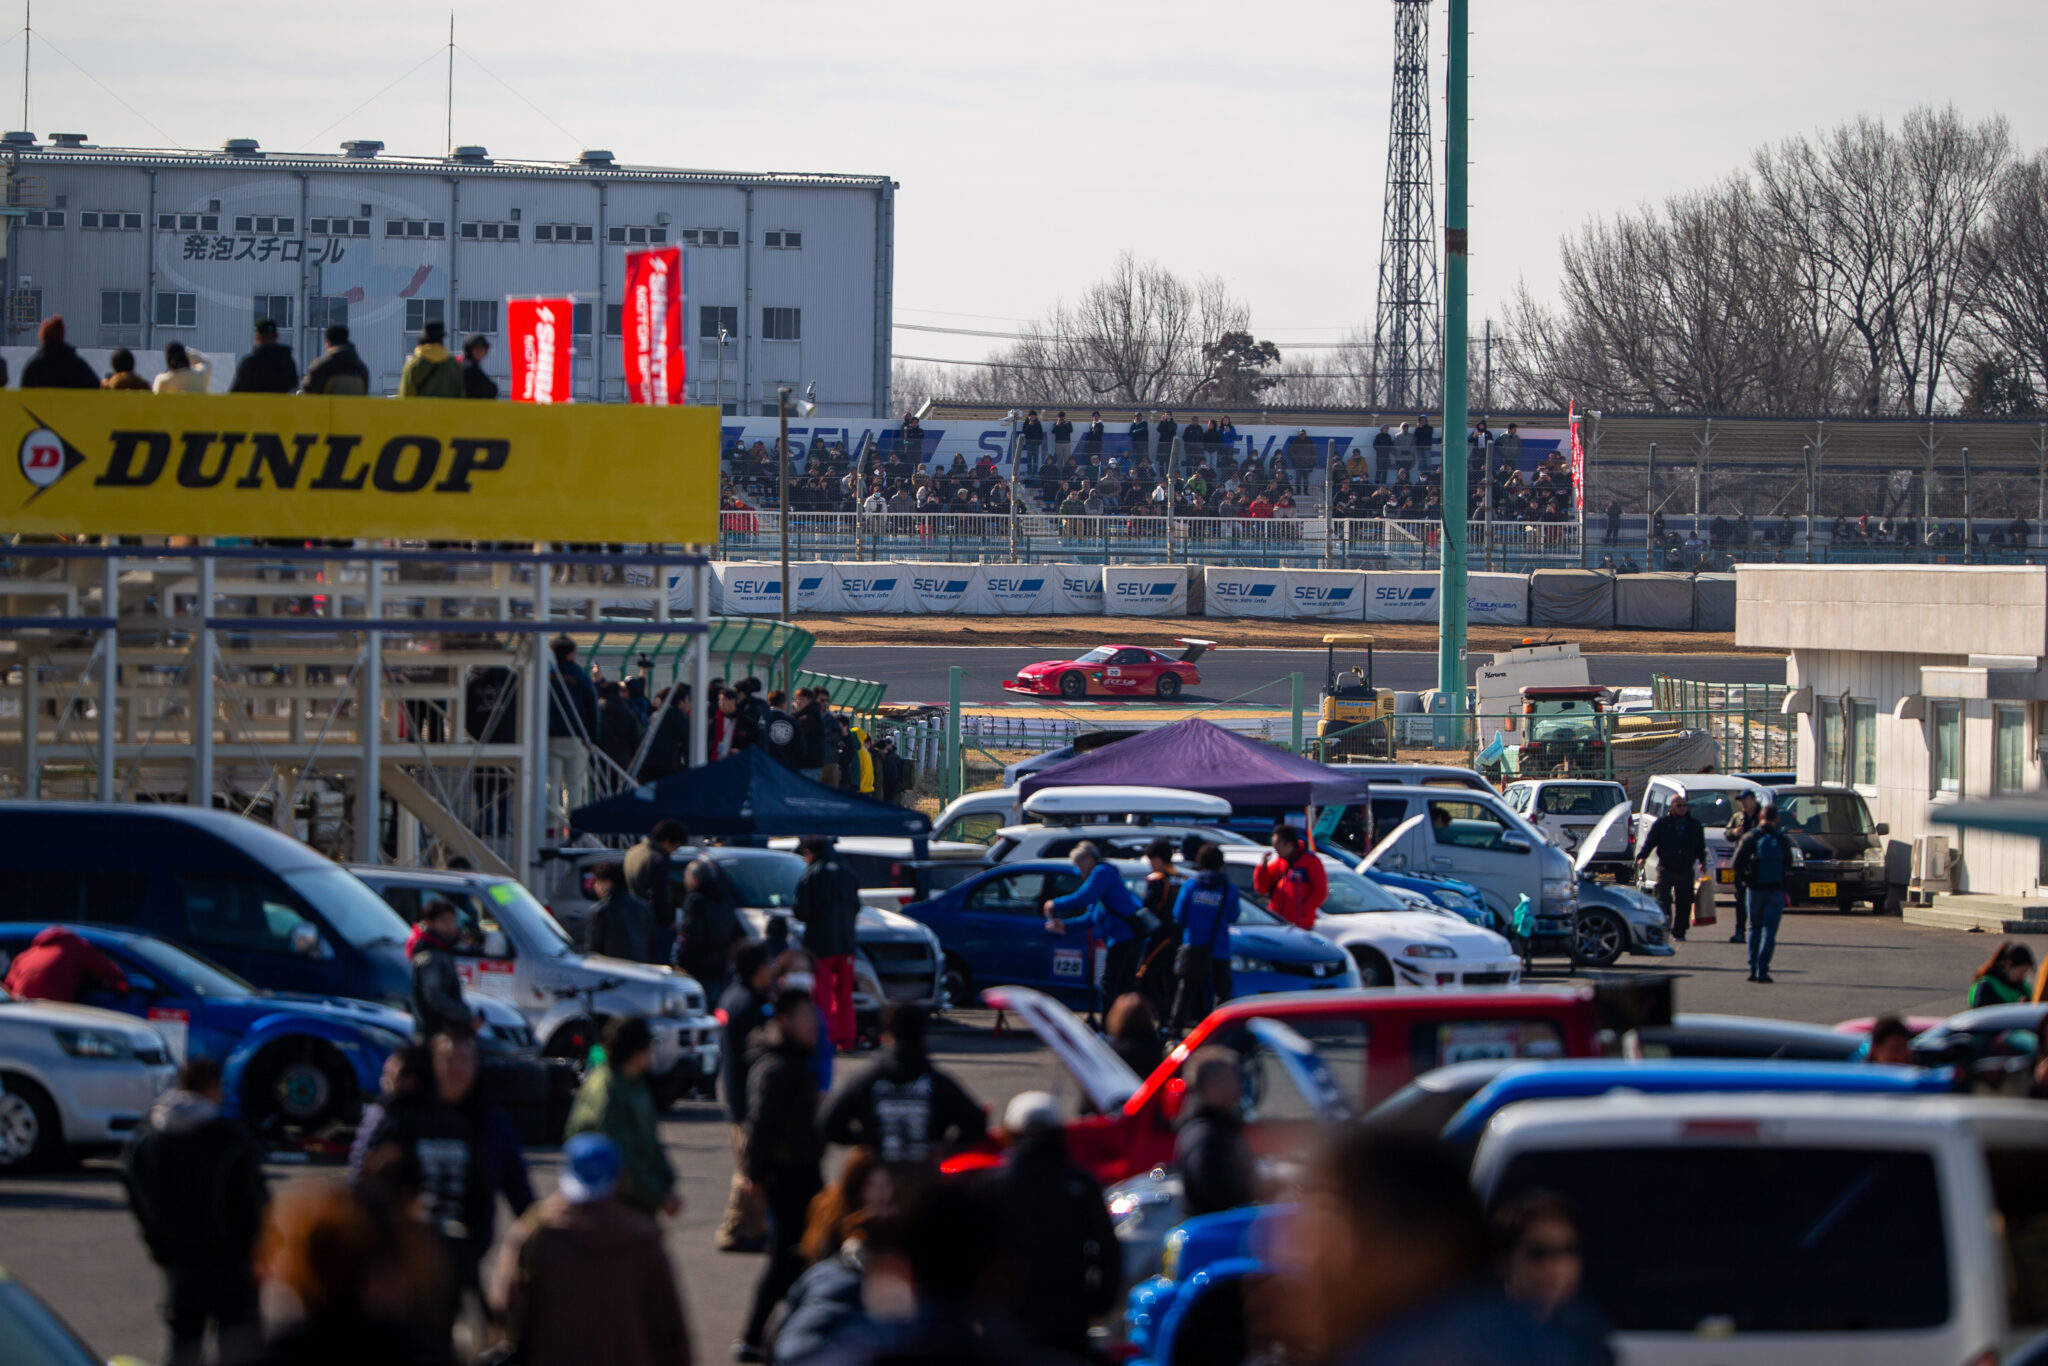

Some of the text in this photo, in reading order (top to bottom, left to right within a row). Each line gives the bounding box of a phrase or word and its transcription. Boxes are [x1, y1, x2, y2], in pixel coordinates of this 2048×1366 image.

[183, 235, 345, 264] 発泡スチロール
[26, 430, 510, 493] D DUNLOP
[733, 580, 765, 593] SEV
[842, 579, 873, 591] SEV
[913, 578, 946, 592] SEV
[987, 579, 1020, 592] SEV
[1062, 579, 1097, 593] SEV
[1116, 583, 1151, 595] SEV
[1216, 582, 1252, 596] SEV
[1294, 586, 1329, 600] SEV
[1376, 586, 1411, 600] SEV
[1055, 960, 1081, 973] 128
